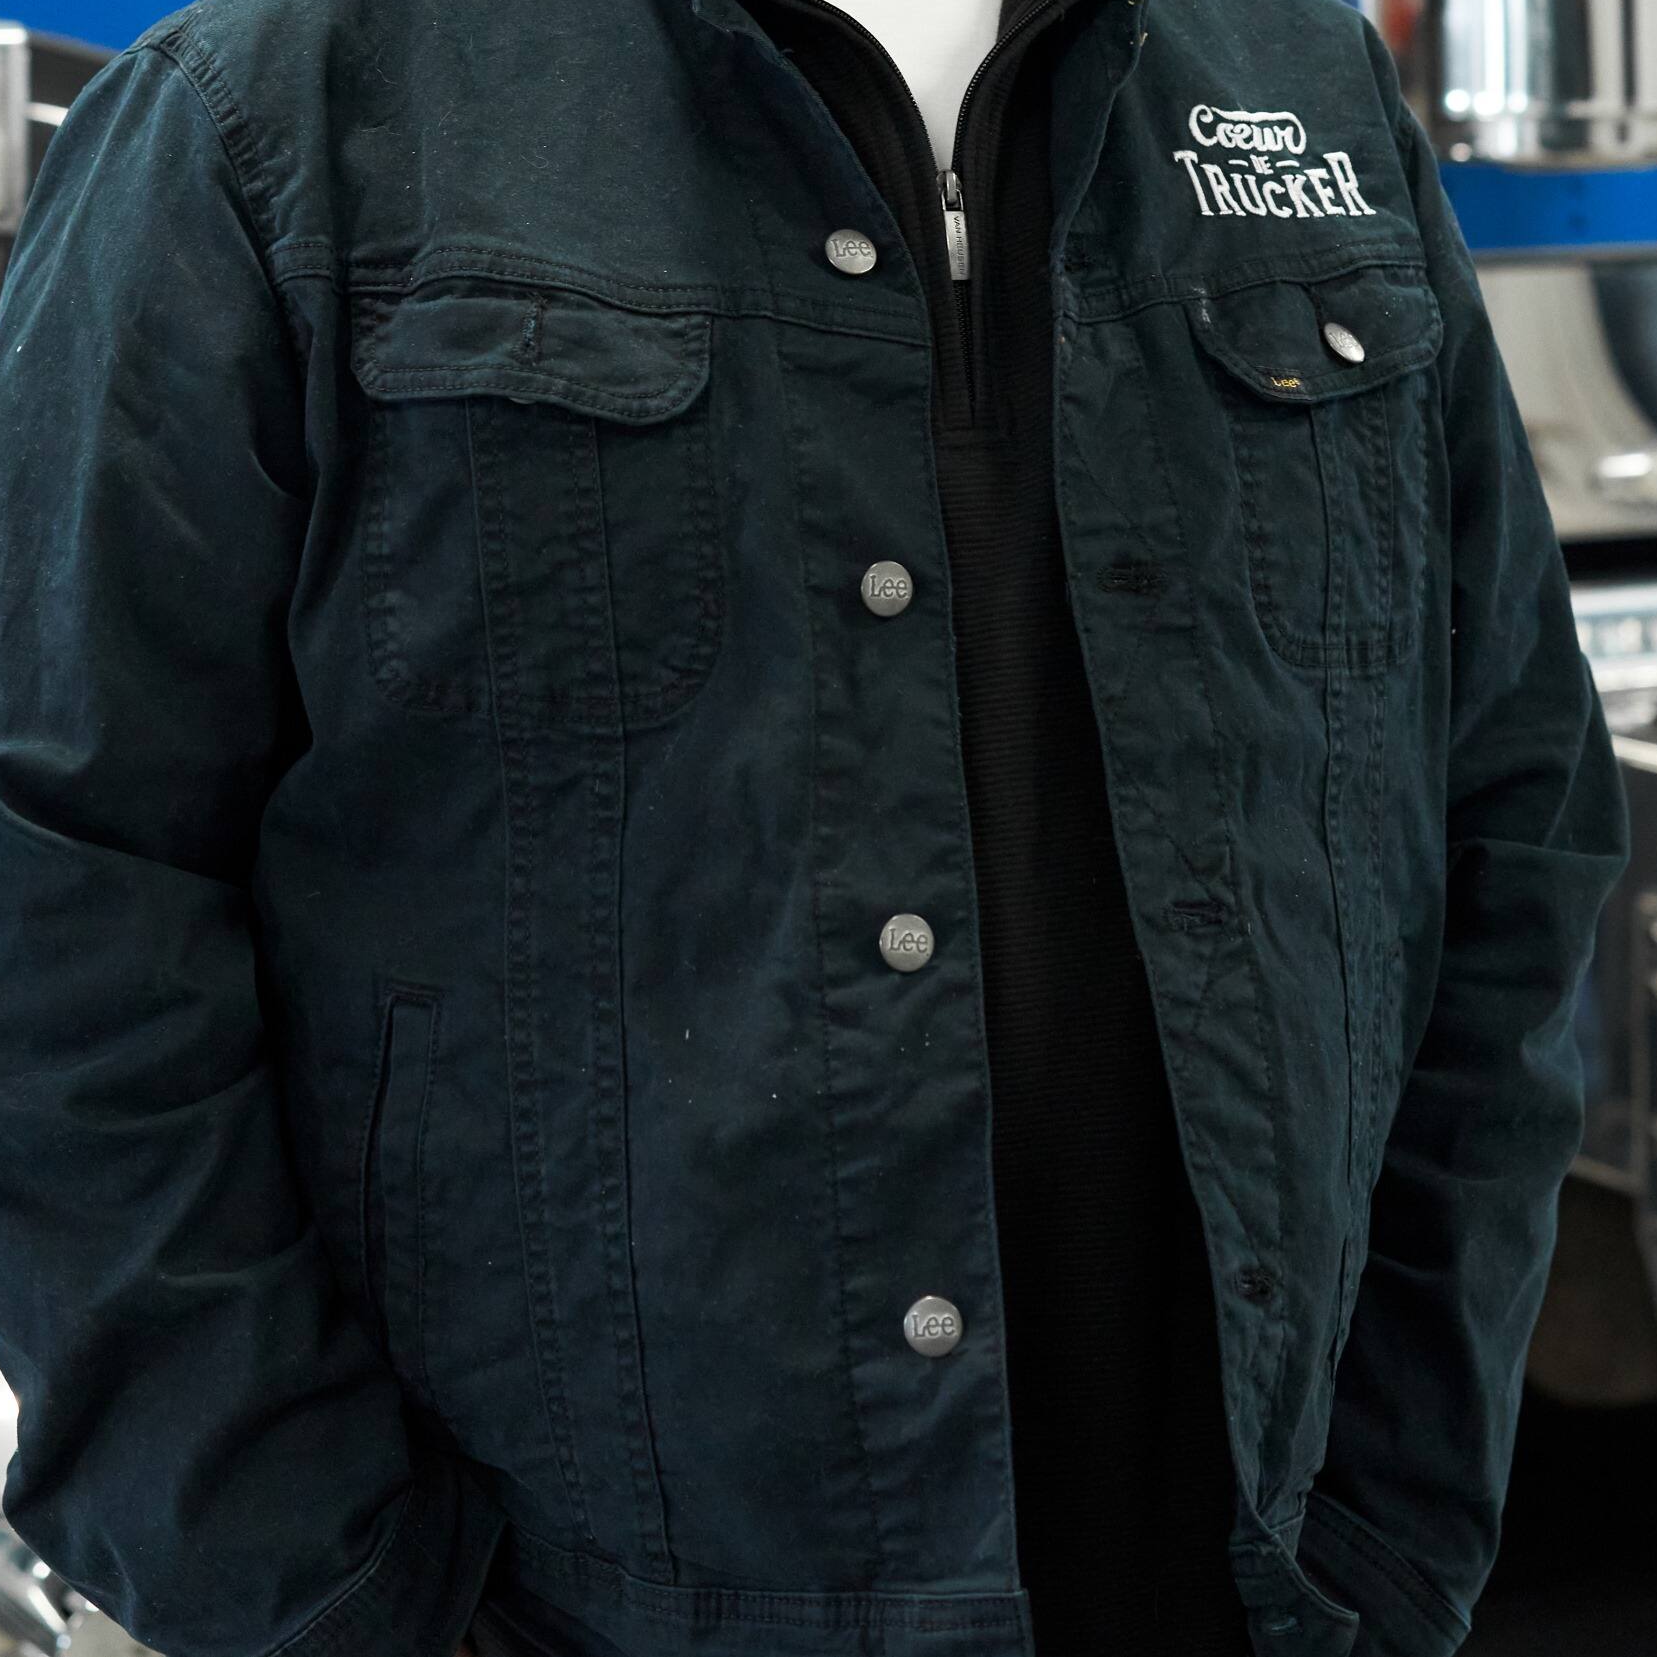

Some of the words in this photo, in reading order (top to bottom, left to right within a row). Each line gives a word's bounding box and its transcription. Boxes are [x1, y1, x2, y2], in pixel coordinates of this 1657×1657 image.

[1250, 154, 1274, 175] DE
[1173, 150, 1377, 218] TRUCKER
[953, 215, 962, 234] VAN
[830, 238, 872, 258] Lee
[868, 574, 908, 599] Lee
[888, 927, 929, 954] Lee
[911, 1314, 956, 1338] Lee
